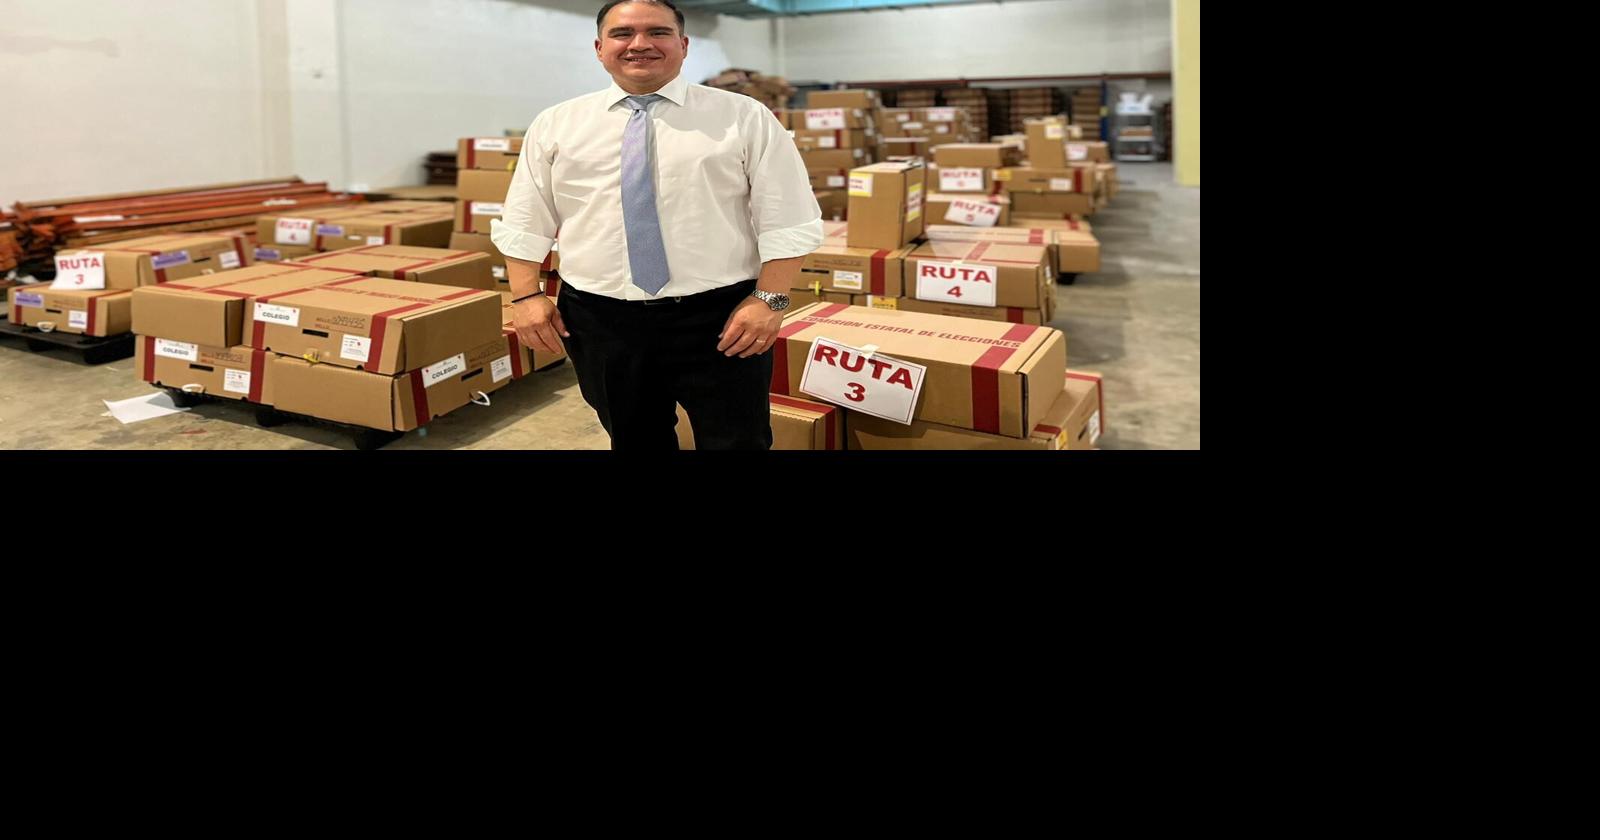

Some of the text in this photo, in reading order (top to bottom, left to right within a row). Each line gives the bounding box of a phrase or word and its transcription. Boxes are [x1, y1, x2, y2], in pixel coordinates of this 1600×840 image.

[953, 200, 996, 216] RUTA
[58, 257, 101, 270] RUTA
[74, 274, 84, 285] 3
[921, 265, 992, 283] RUTA
[947, 285, 962, 298] 4
[262, 311, 290, 321] COLEGIO
[801, 316, 1021, 348] COMISION ESTATAL DE ELECCIONES
[162, 346, 189, 356] COLEGIO
[431, 364, 458, 380] COLEGIO
[813, 344, 914, 391] RUTA
[843, 381, 866, 402] 3
